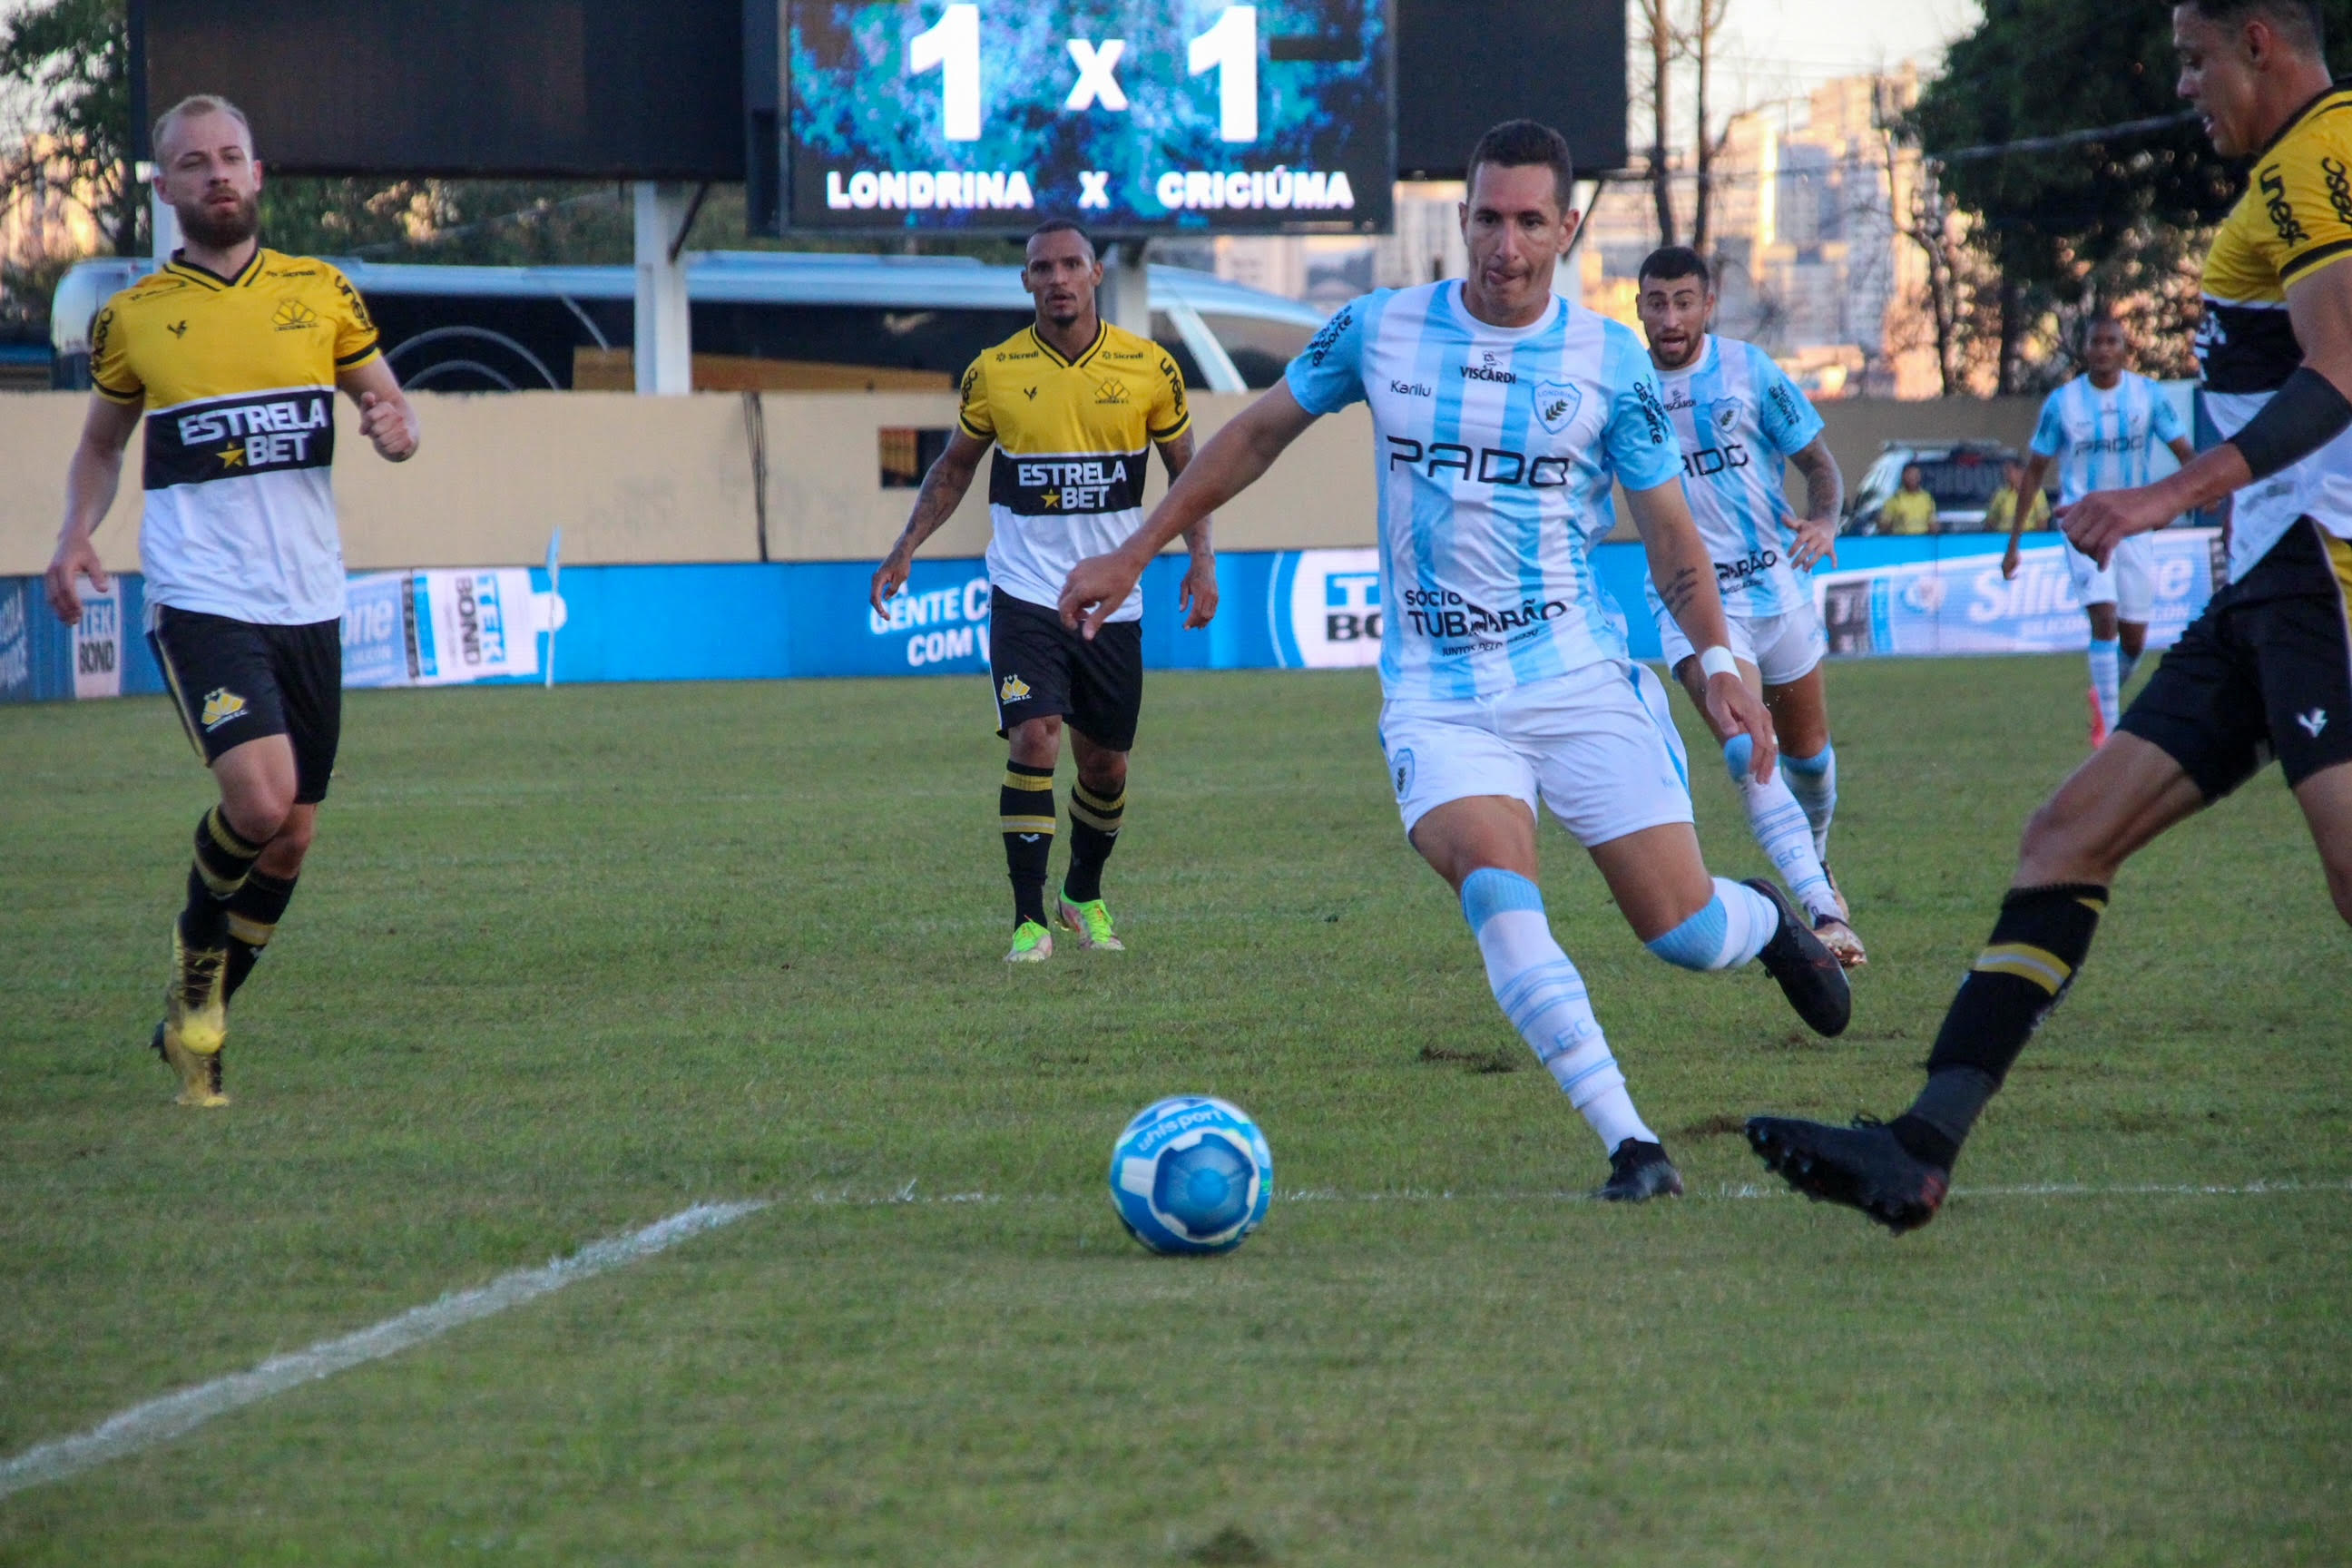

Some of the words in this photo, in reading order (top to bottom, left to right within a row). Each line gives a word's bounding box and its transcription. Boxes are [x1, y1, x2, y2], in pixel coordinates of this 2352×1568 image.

[909, 3, 981, 142] 1
[1188, 5, 1258, 143] 1
[827, 170, 1034, 210] LONDRINA
[1078, 171, 1109, 209] X
[1156, 164, 1356, 210] CRICIÚMA
[1008, 349, 1040, 361] Sicredi
[1112, 350, 1144, 361] Sicredi
[1459, 365, 1517, 385] VISCARDI
[1160, 357, 1186, 416] unesc
[1389, 379, 1432, 397] Karilu
[177, 397, 328, 447] ESTRELA
[244, 431, 312, 466] BET
[1387, 435, 1570, 488] PADO
[1017, 460, 1128, 487] ESTRELA
[1061, 485, 1111, 511] BET
[870, 586, 962, 635] GENTE
[1405, 585, 1464, 607] SÓCIO
[455, 576, 482, 666] BOND
[907, 625, 974, 667] COM
[1136, 1108, 1223, 1152] uhlsport
